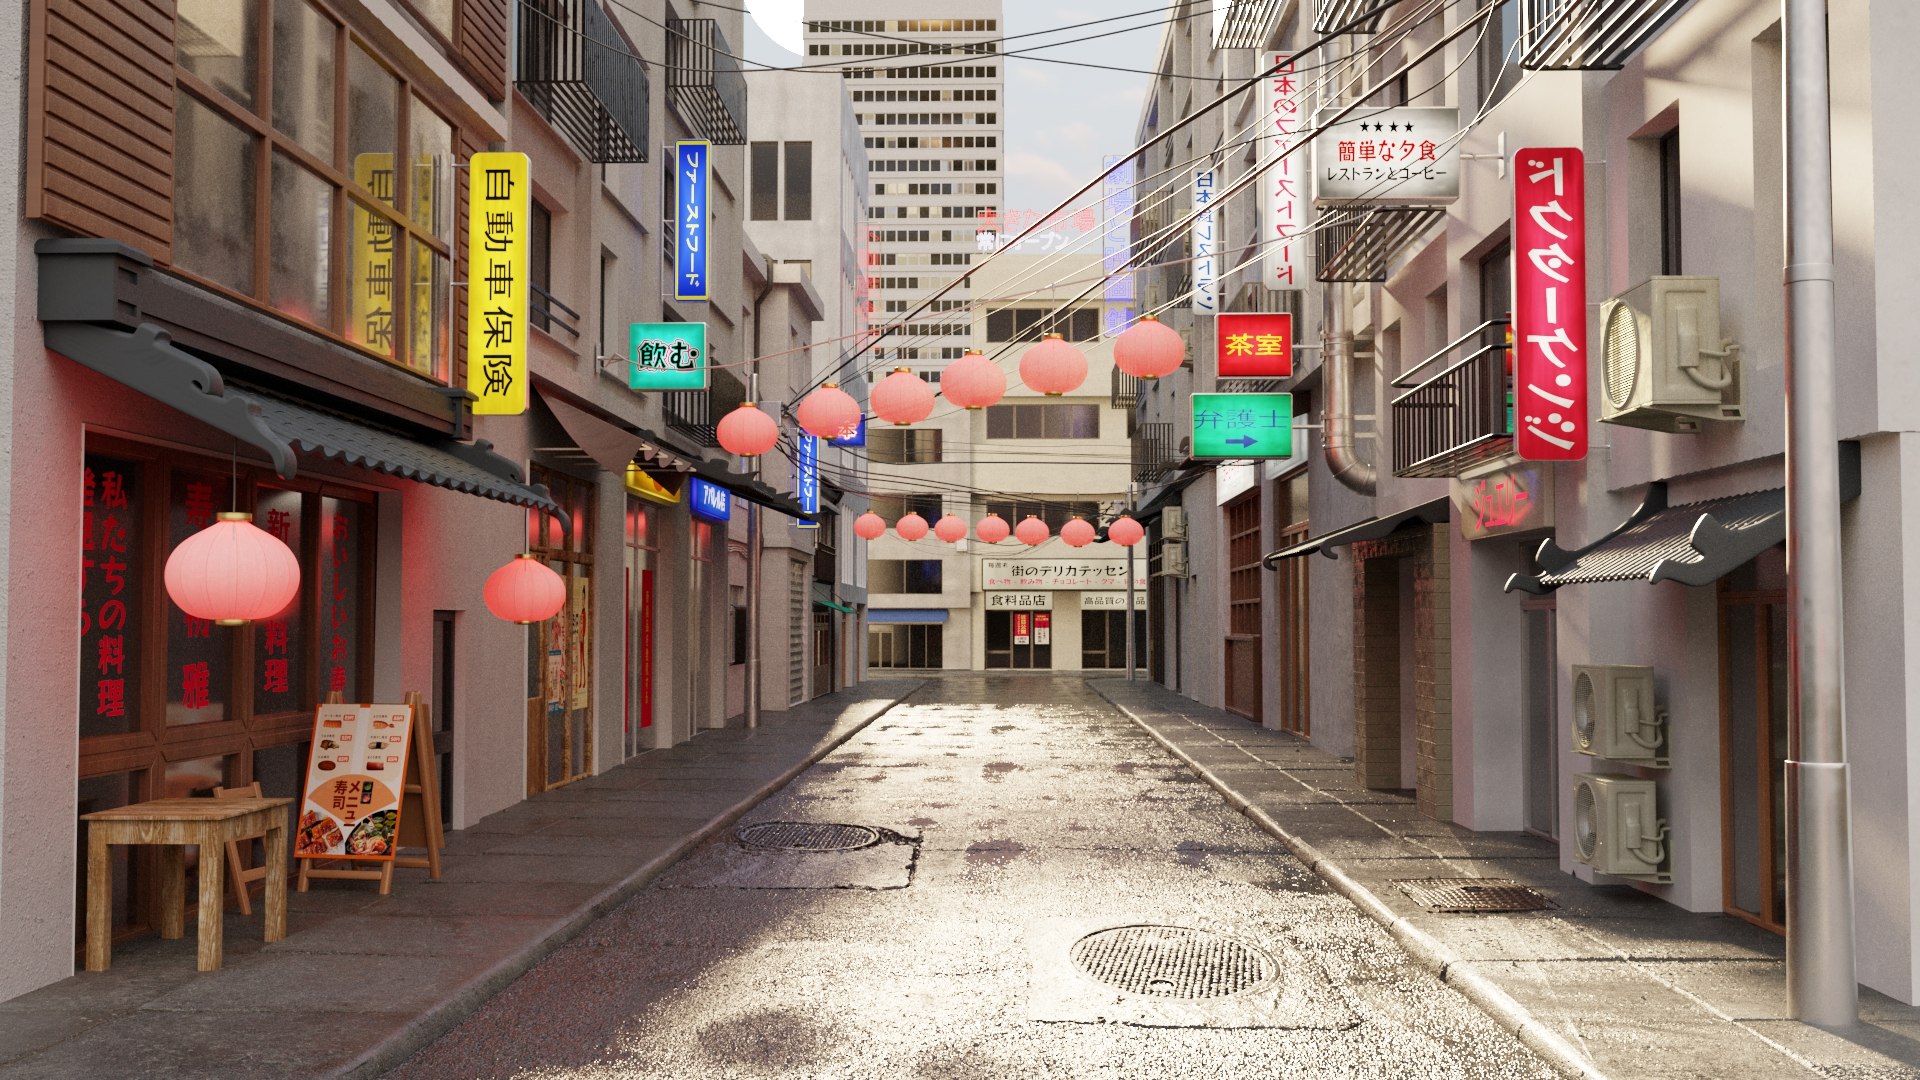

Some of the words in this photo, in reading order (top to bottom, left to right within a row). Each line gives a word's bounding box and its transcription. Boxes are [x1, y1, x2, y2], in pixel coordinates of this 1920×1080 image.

[1338, 139, 1436, 162] 簡単な夕食
[1327, 167, 1447, 181] レストランとコーヒー
[685, 151, 700, 288] ファーストフード
[483, 169, 515, 397] 自動車保険
[638, 340, 699, 371] 飲む
[1225, 333, 1284, 356] 茶室
[1194, 408, 1289, 429] 弁護士
[803, 435, 813, 514] ファーストフー
[1474, 472, 1529, 530] ジュエリー
[1011, 565, 1128, 577] 街のデリカテッセン
[96, 470, 127, 718] 私たちの料理
[329, 511, 349, 704] おいしいお寿
[991, 594, 1046, 606] 食料品店
[1084, 596, 1146, 606] 高品質の品
[332, 780, 348, 810] 寿司
[343, 780, 361, 827] メニュー
